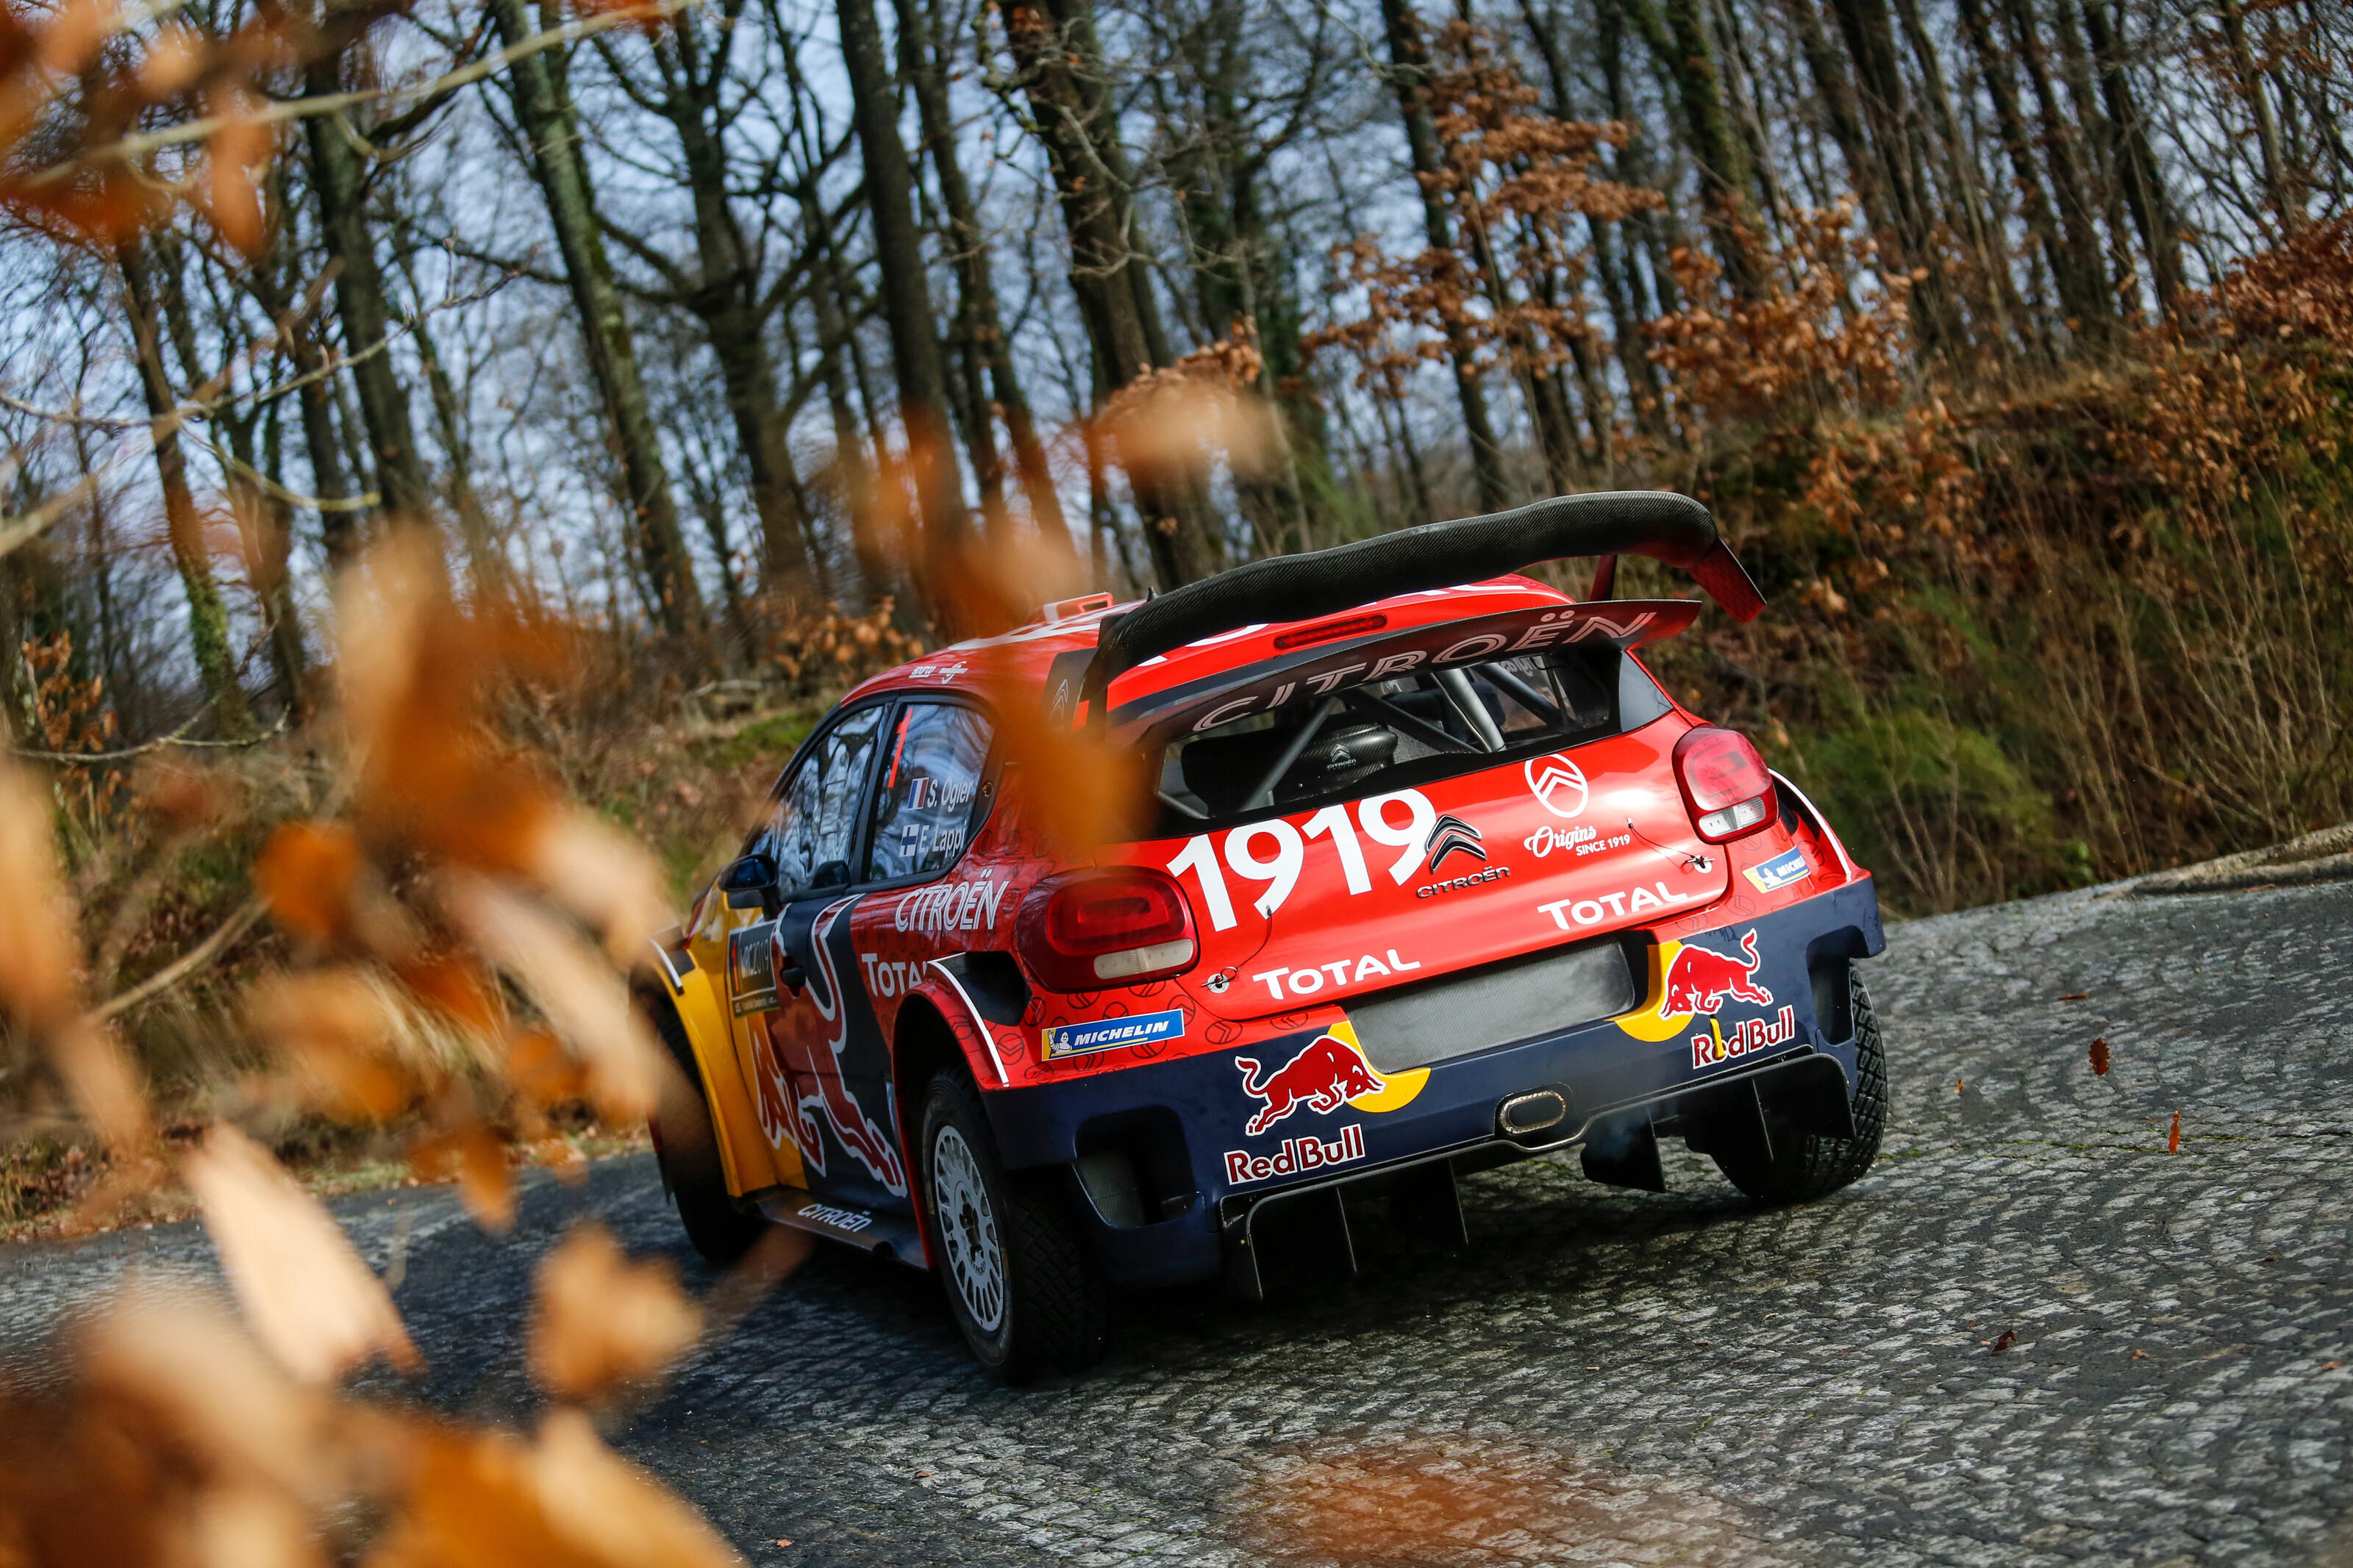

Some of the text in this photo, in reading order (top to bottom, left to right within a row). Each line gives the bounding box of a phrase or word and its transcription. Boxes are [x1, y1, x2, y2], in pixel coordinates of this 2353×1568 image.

[1192, 609, 1657, 732] CITROËN
[888, 708, 913, 788] 1
[927, 776, 974, 812] S. Ogier
[918, 819, 967, 858] E. Lappi
[1524, 825, 1598, 858] Origins
[1575, 834, 1631, 856] SINCE 1919
[1166, 787, 1437, 932] 1919
[895, 868, 1010, 933] CITROËN
[1416, 865, 1511, 898] CITROËN
[1537, 881, 1688, 930] TOTAL
[1252, 948, 1421, 1000] TOTAL
[1074, 1020, 1170, 1047] MICHELIN
[797, 1203, 872, 1232] CITROËN
